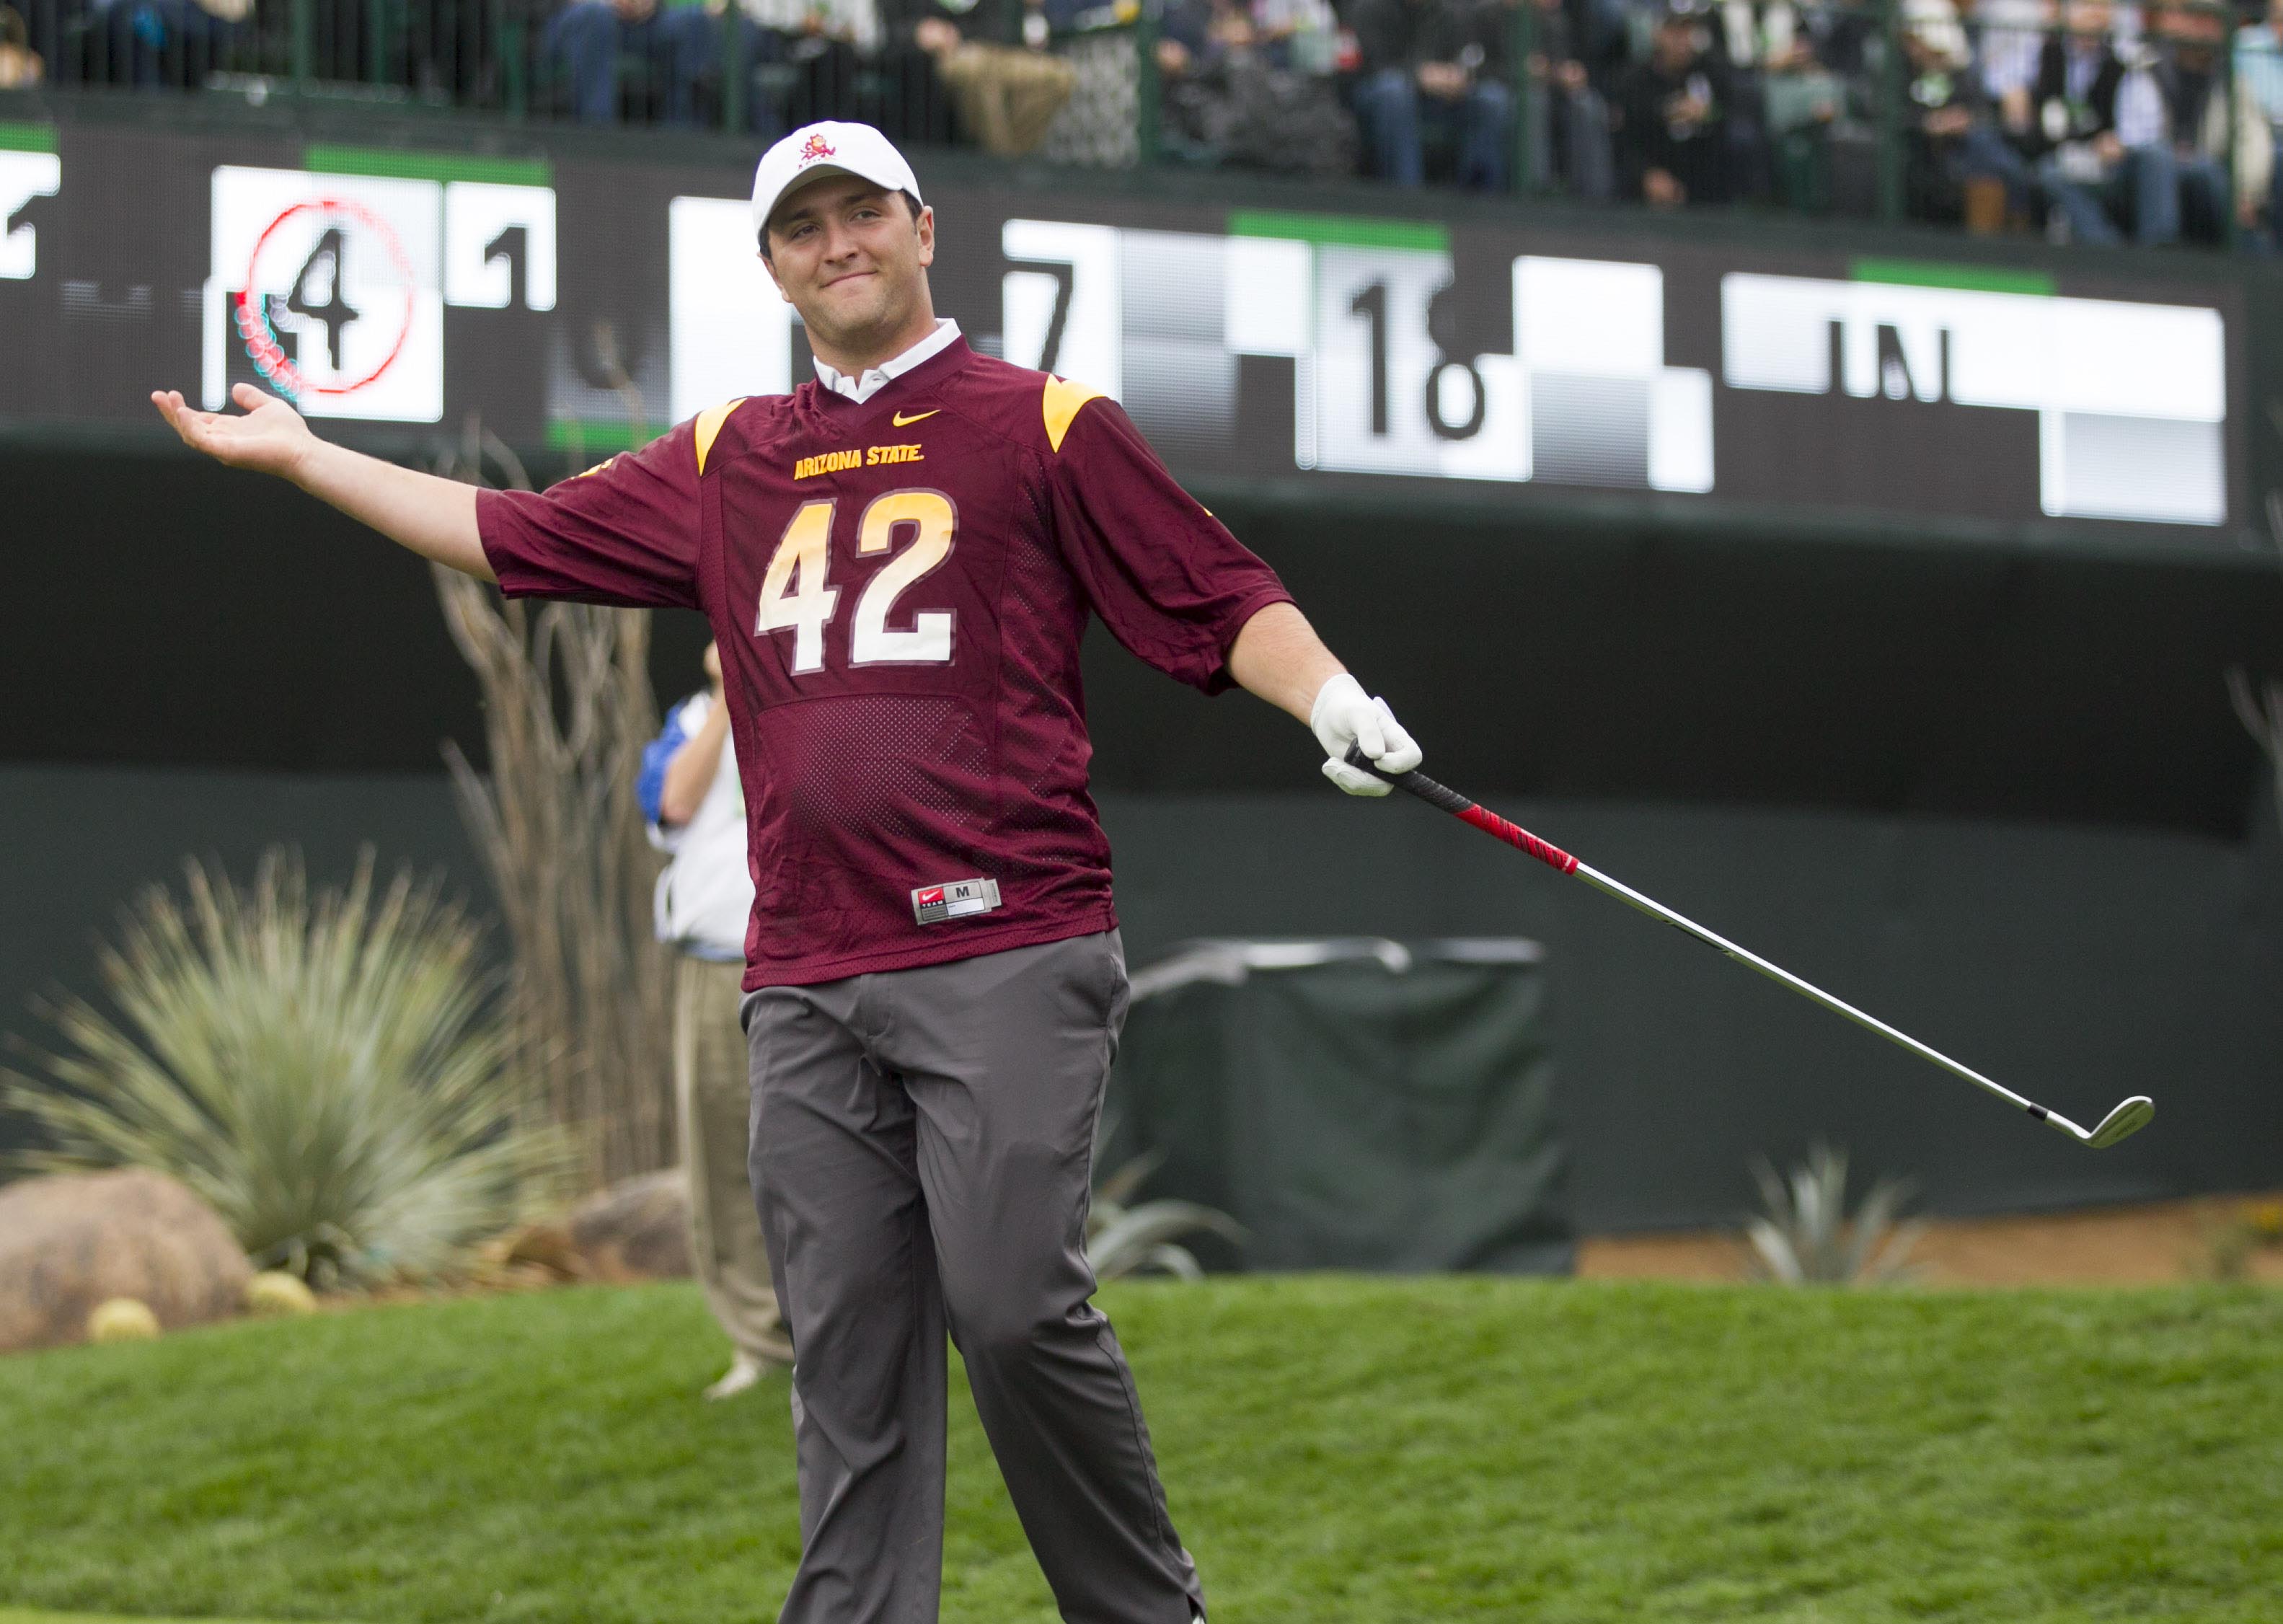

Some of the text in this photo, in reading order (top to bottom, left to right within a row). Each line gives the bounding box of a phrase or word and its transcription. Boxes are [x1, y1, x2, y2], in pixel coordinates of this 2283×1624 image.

[277, 225, 359, 374] 4
[794, 449, 862, 480] ARIZONA
[754, 487, 958, 676] 42
[955, 886, 970, 898] M
